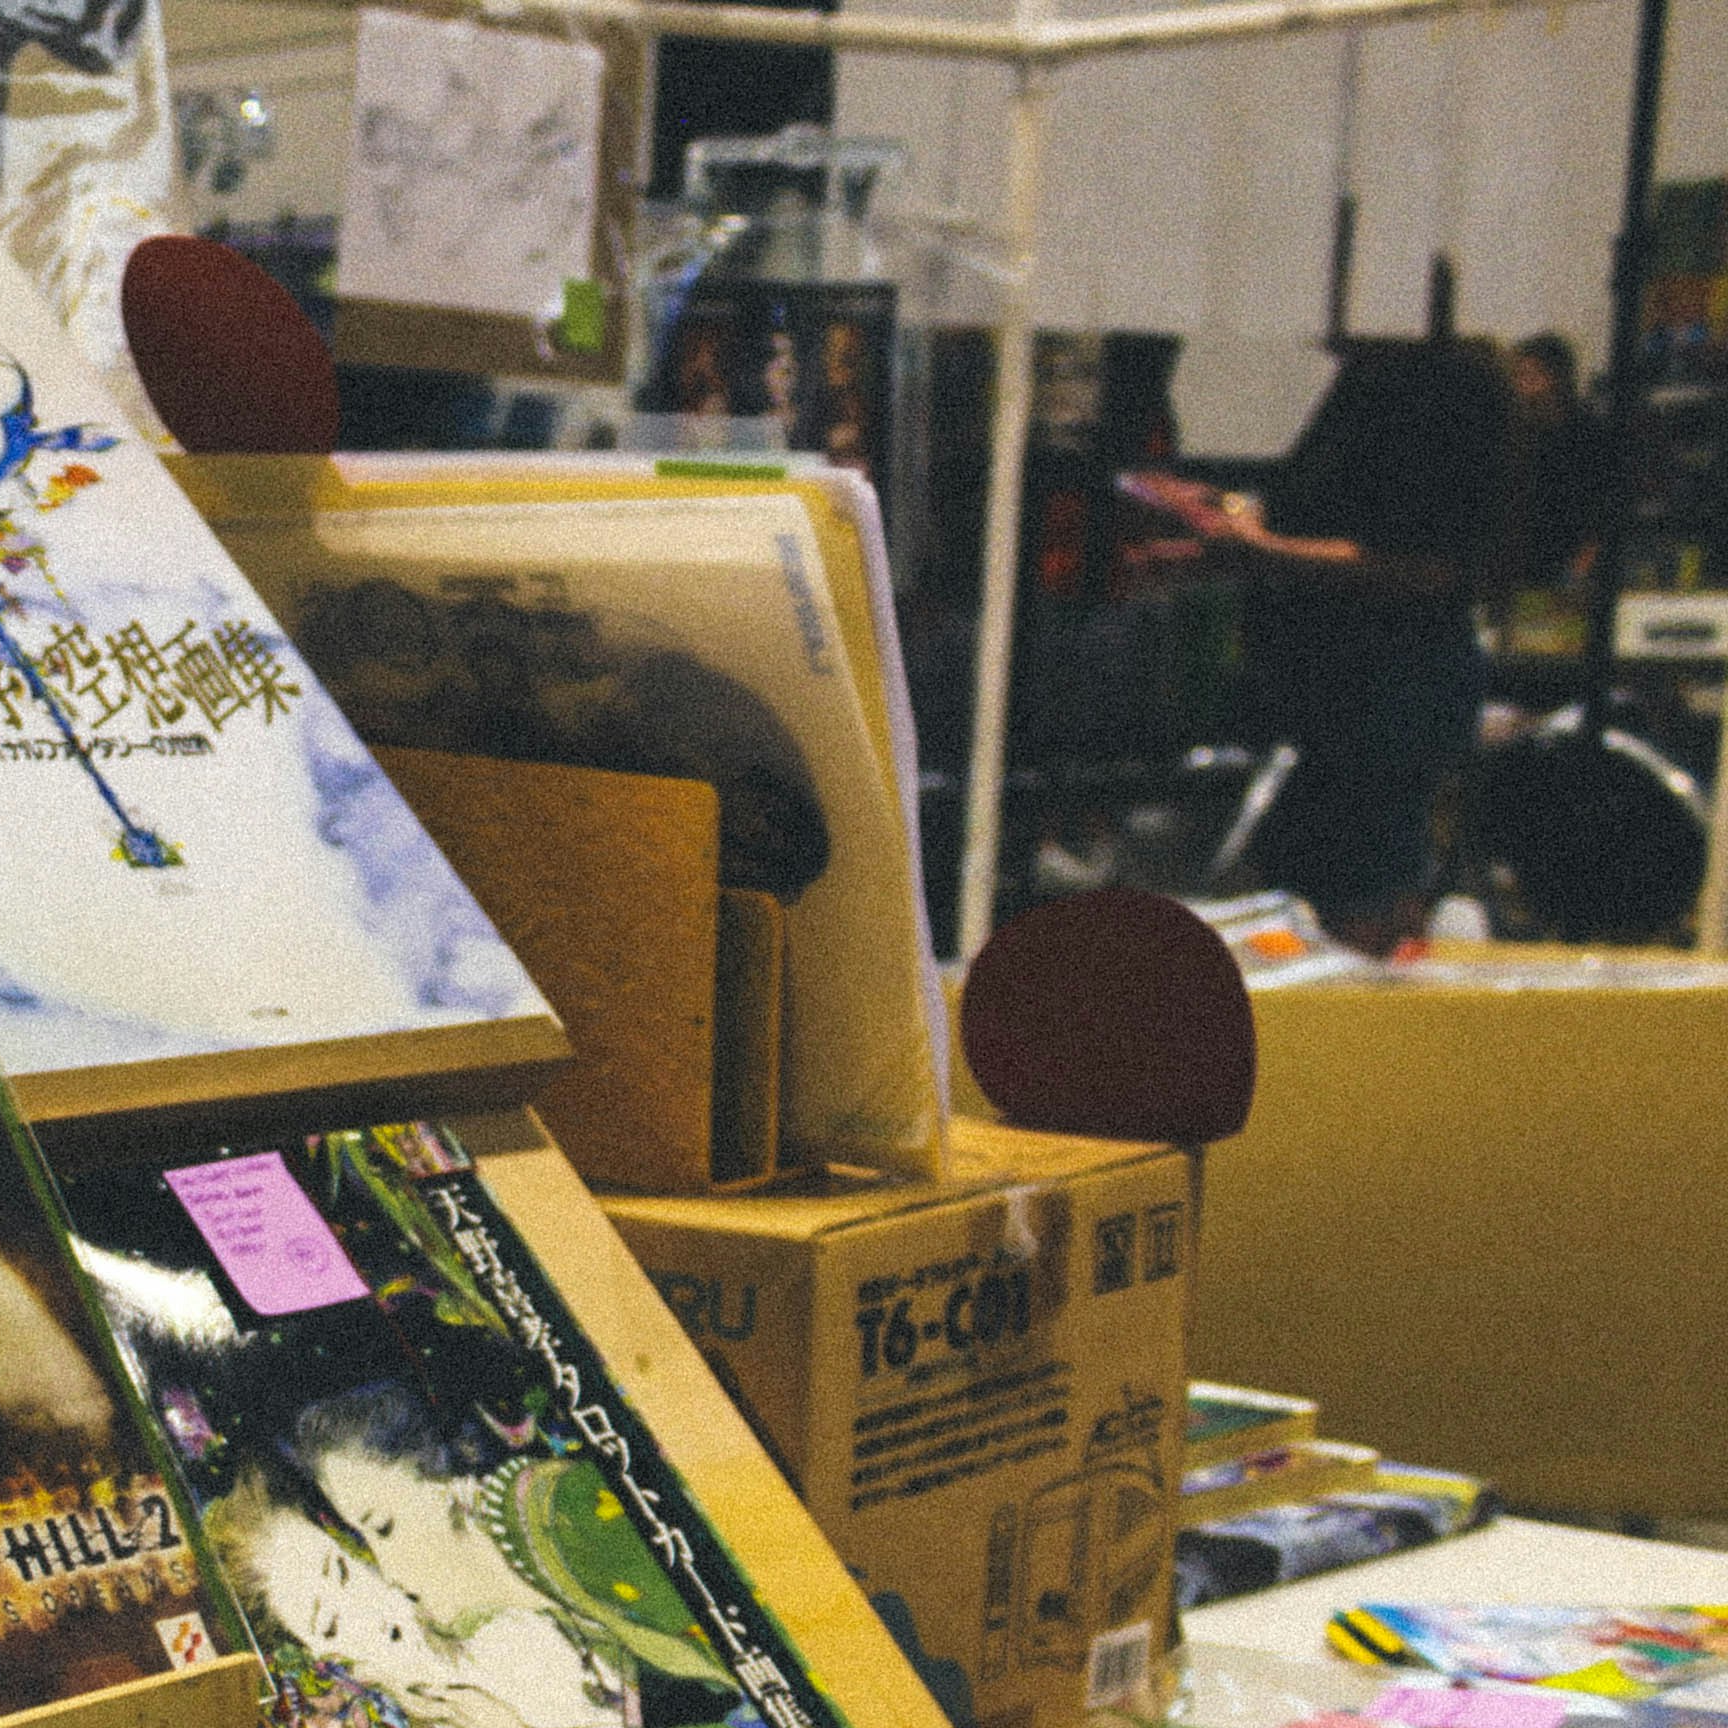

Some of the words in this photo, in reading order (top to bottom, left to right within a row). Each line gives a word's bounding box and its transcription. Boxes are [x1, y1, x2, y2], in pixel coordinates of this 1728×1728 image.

[4, 1507, 142, 1582] HILL
[141, 1495, 182, 1550] 2
[41, 1558, 189, 1615] DREAMS
